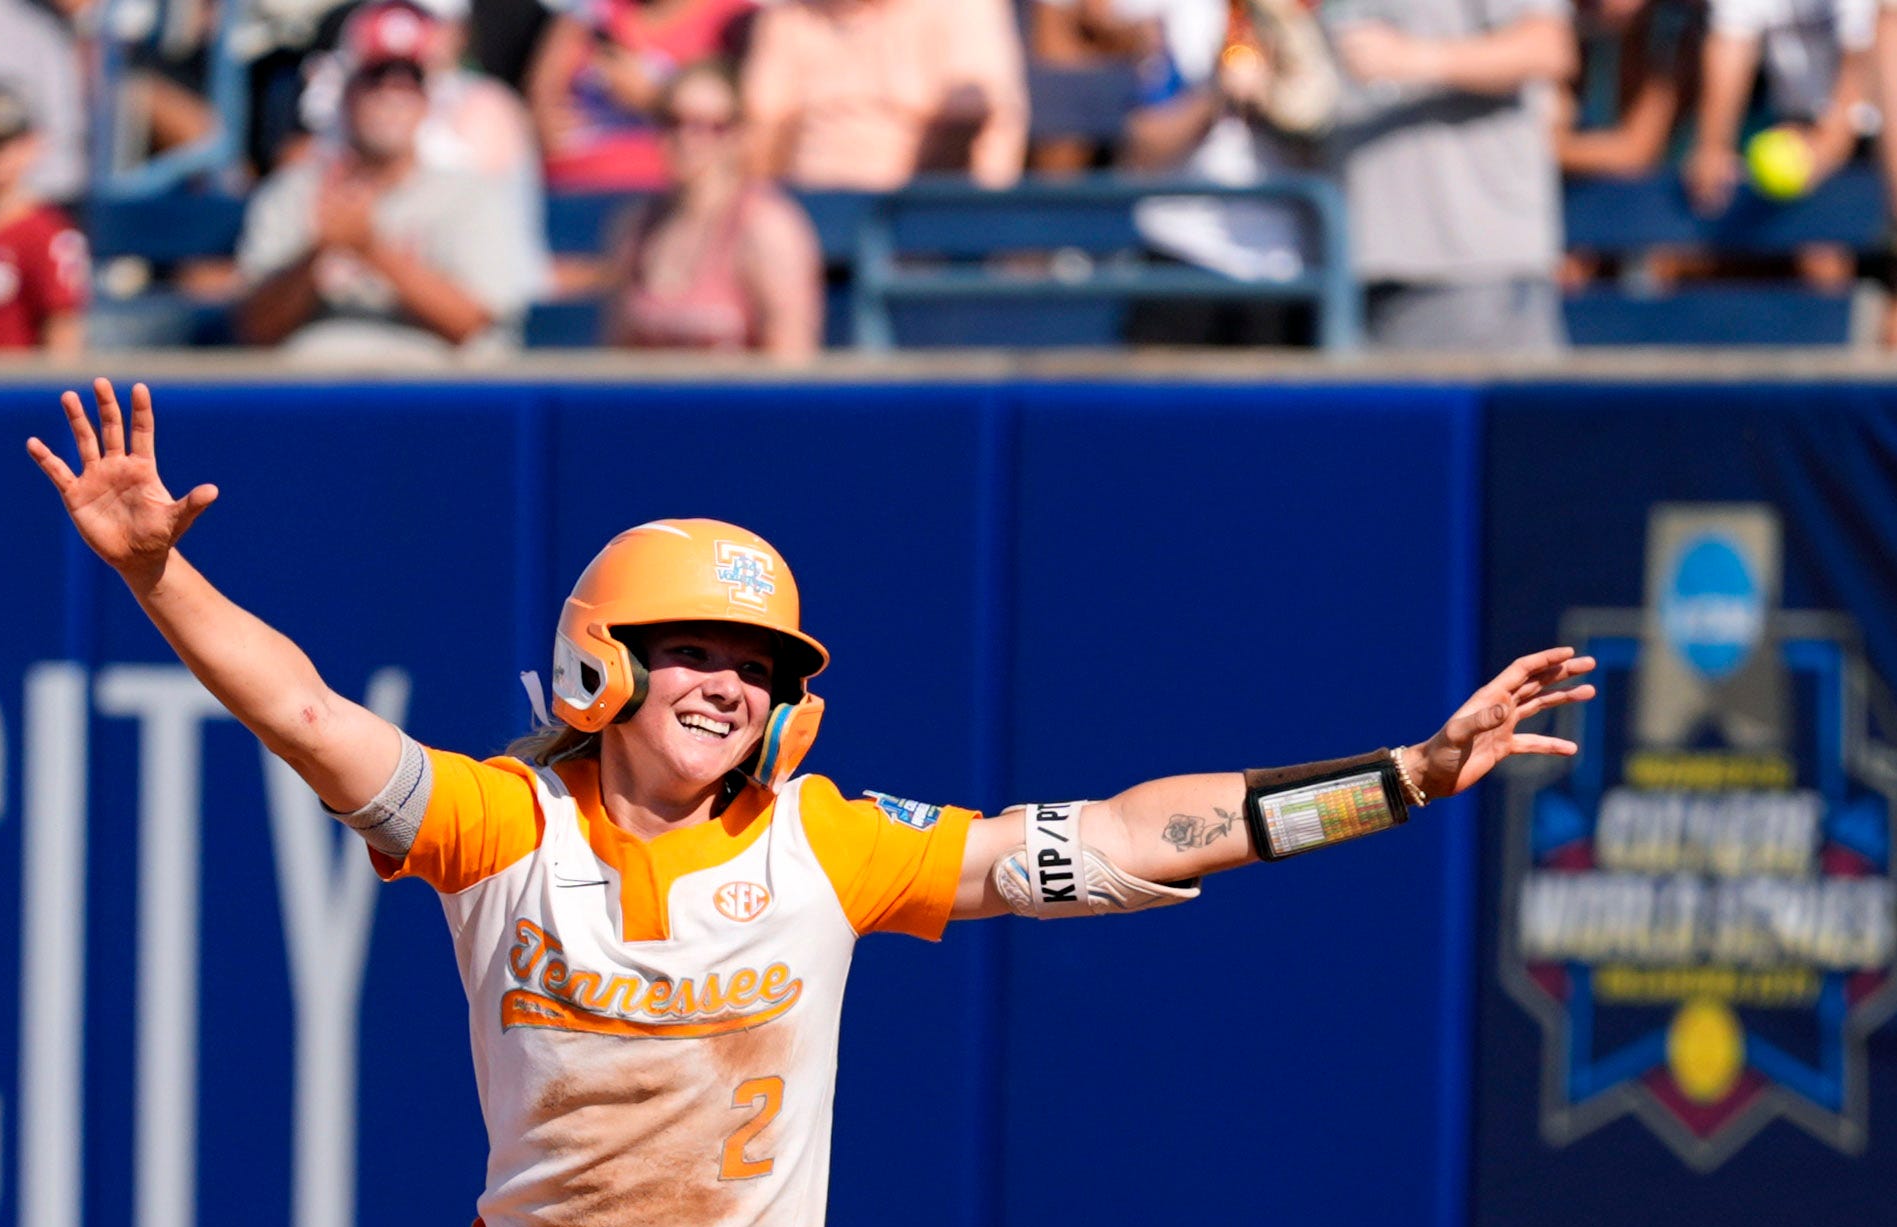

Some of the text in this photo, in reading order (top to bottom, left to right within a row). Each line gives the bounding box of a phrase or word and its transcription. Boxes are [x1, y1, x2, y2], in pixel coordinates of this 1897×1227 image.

[717, 882, 768, 919] SEC
[1037, 848, 1078, 903] KTP
[505, 917, 803, 1022] Tennessee
[718, 1074, 786, 1182] 2
